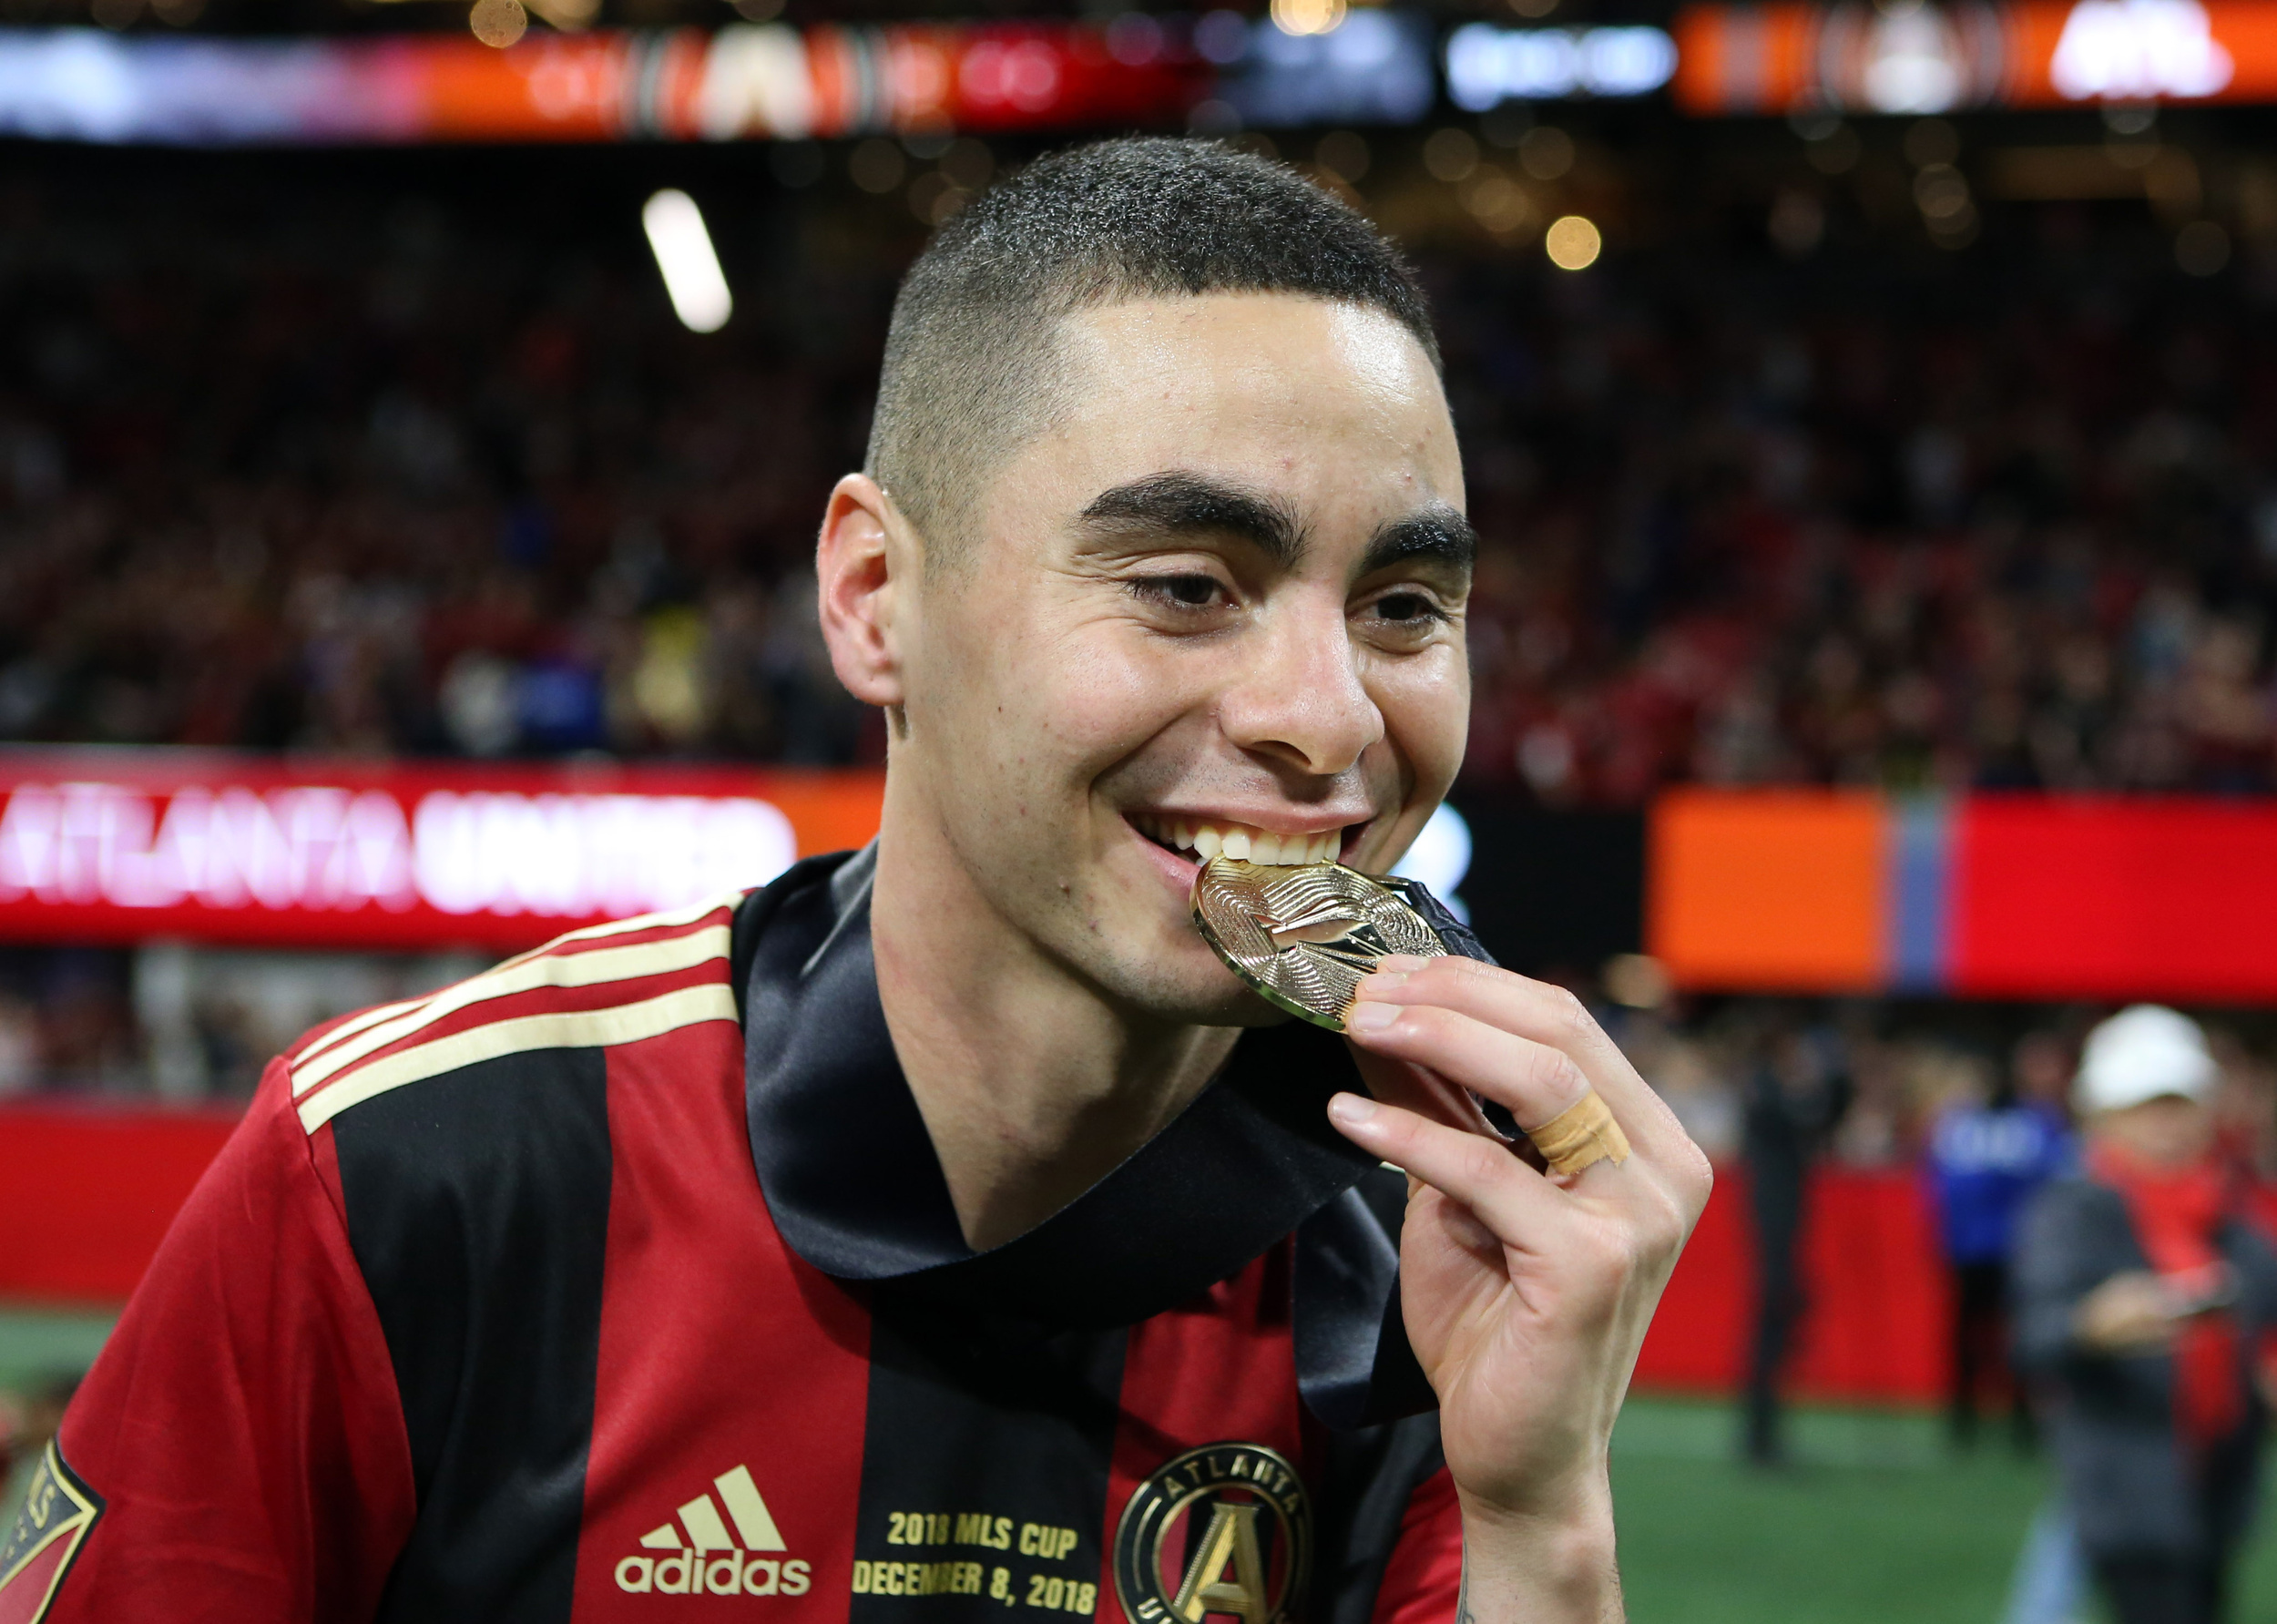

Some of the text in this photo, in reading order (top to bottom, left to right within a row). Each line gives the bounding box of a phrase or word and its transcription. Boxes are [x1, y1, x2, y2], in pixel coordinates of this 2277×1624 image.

[0, 781, 412, 913] ATLANTA
[1163, 1454, 1301, 1514] ATLANTA
[886, 1511, 1079, 1561] 2018 MLS CUP
[614, 1547, 812, 1596] adidas
[989, 1566, 1016, 1609] 8,
[1025, 1574, 1098, 1616] 2018
